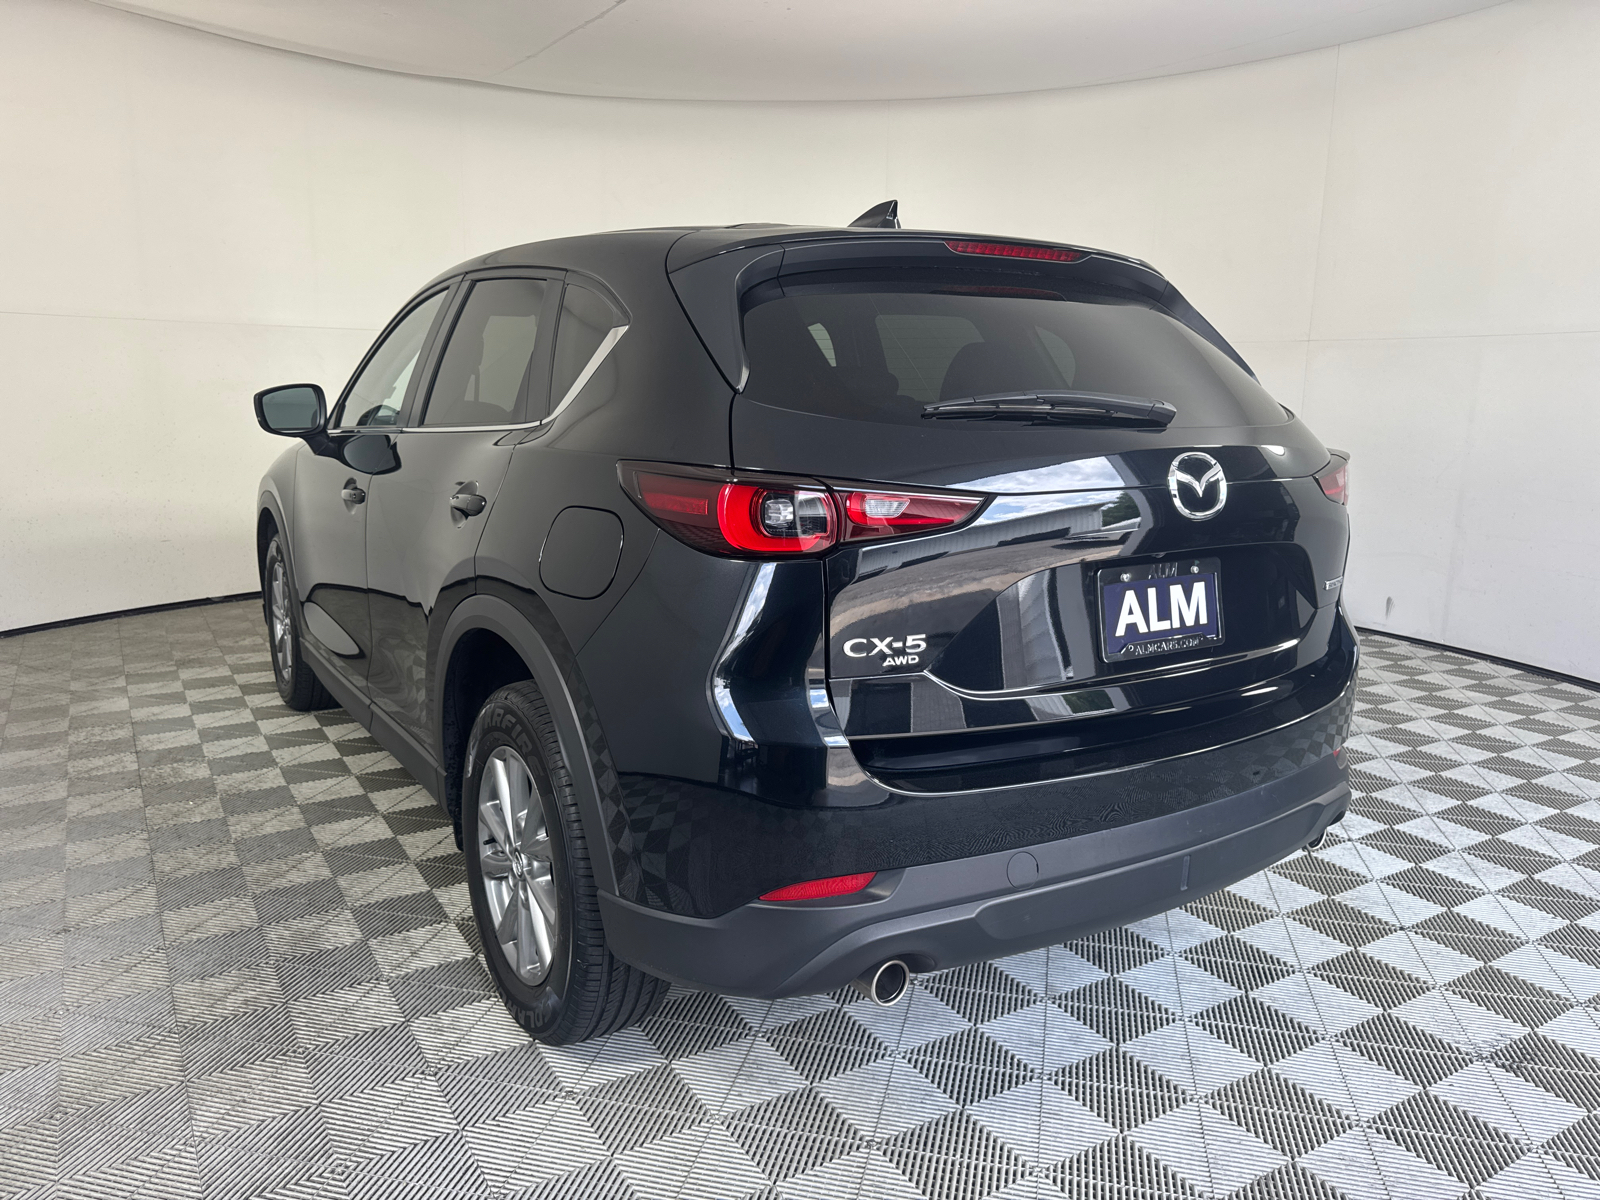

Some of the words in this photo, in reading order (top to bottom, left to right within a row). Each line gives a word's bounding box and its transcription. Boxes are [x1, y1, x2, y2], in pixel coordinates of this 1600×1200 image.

[1148, 562, 1178, 579] ALM
[1115, 581, 1208, 637] ALM
[843, 633, 927, 658] CX-5
[1135, 637, 1200, 656] ALMCARS.COM
[882, 655, 920, 667] AWD
